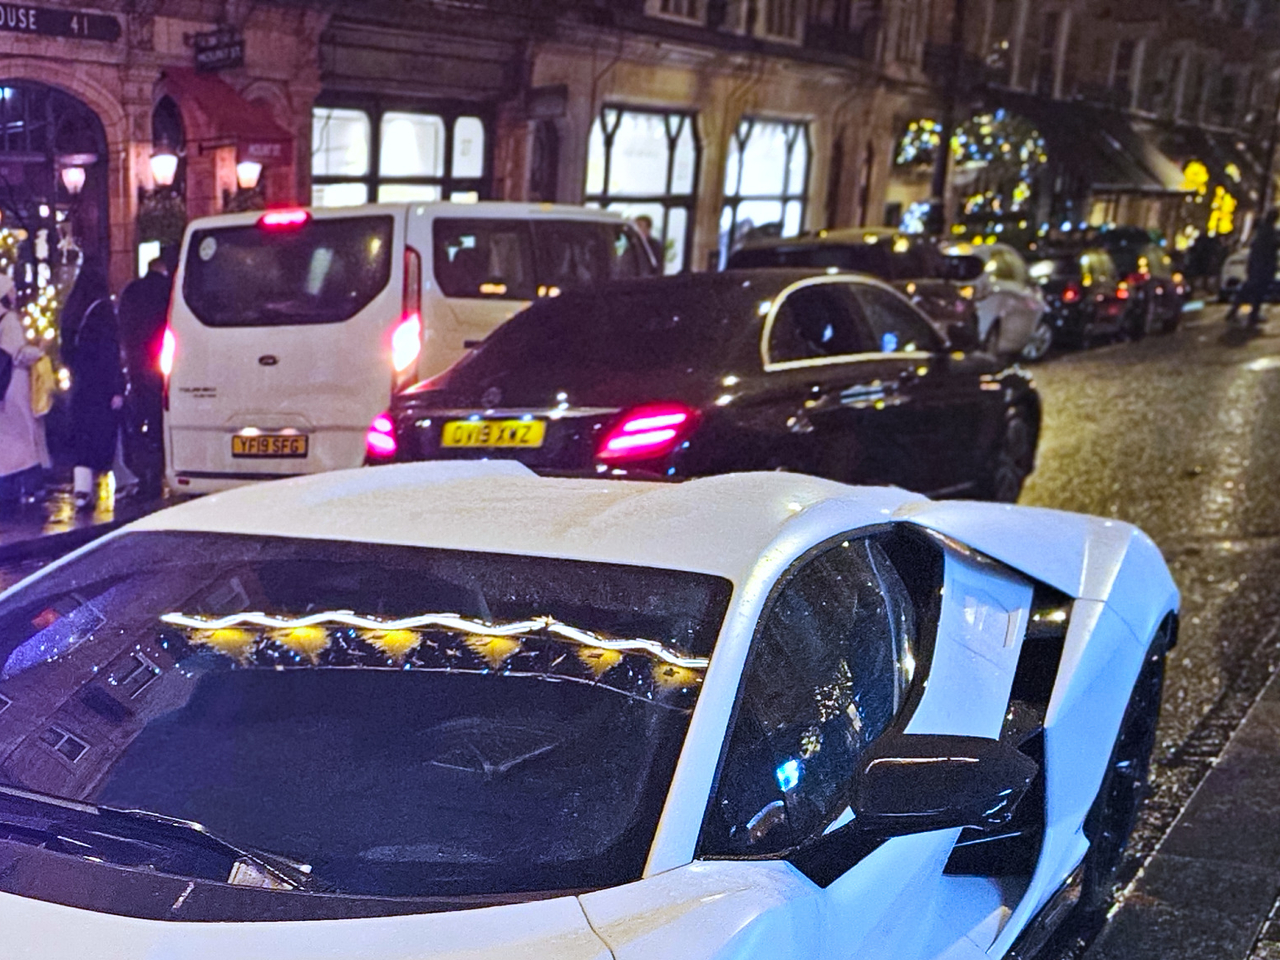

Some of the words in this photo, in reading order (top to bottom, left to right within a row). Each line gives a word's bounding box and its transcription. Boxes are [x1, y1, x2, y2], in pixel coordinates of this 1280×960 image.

[70, 15, 89, 35] 41
[239, 438, 269, 453] YF19
[272, 438, 299, 454] SFG
